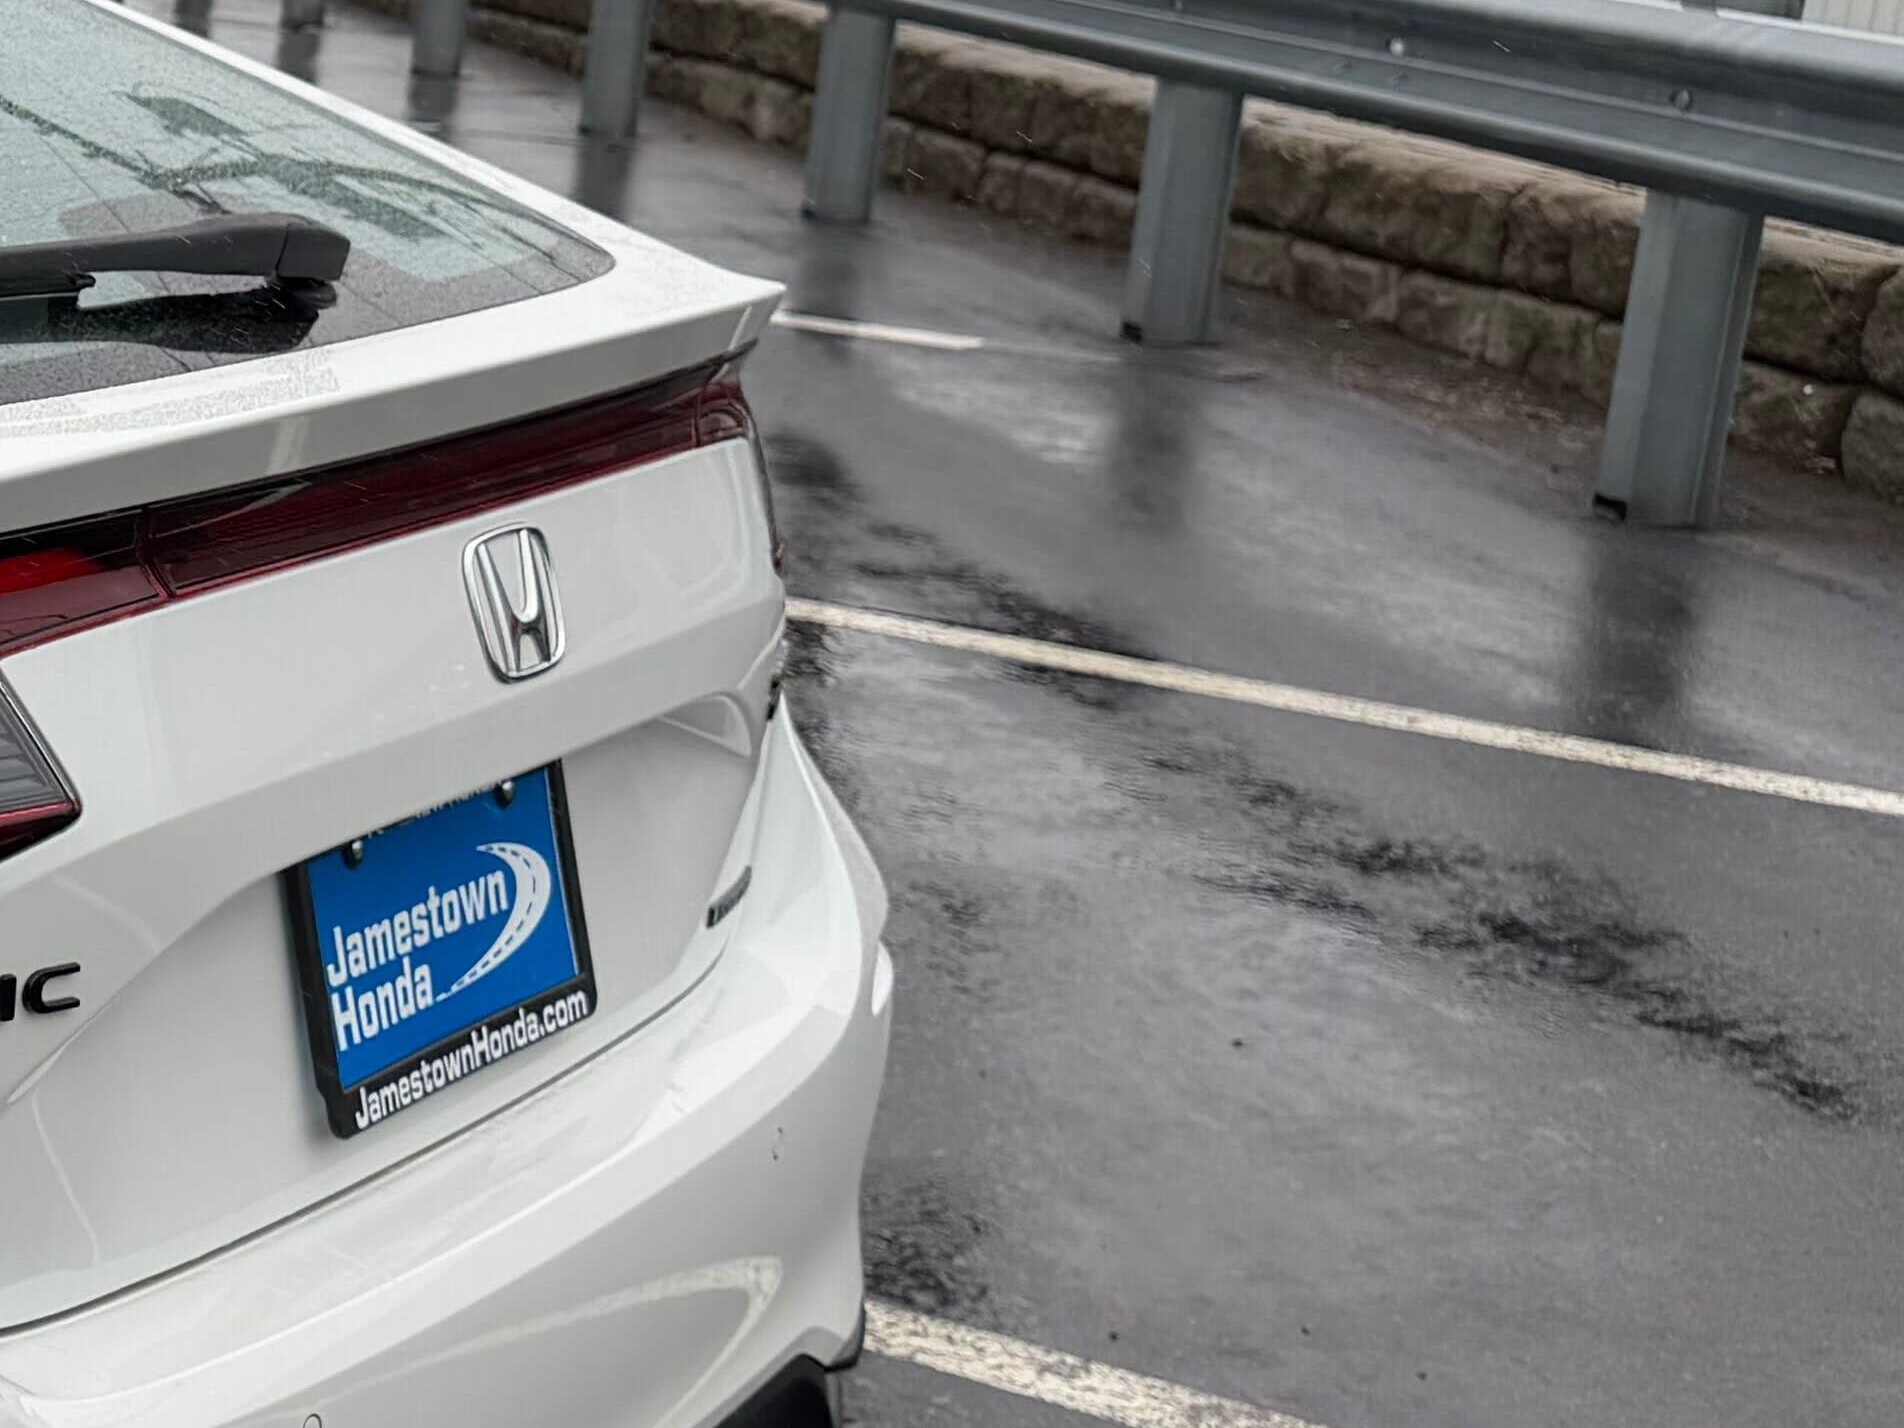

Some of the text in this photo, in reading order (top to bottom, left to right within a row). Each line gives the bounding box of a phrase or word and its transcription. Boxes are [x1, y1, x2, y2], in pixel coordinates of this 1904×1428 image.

[327, 869, 510, 988] Jamestown
[331, 957, 435, 1051] Honda
[354, 989, 589, 1130] JamestownHonda.com
